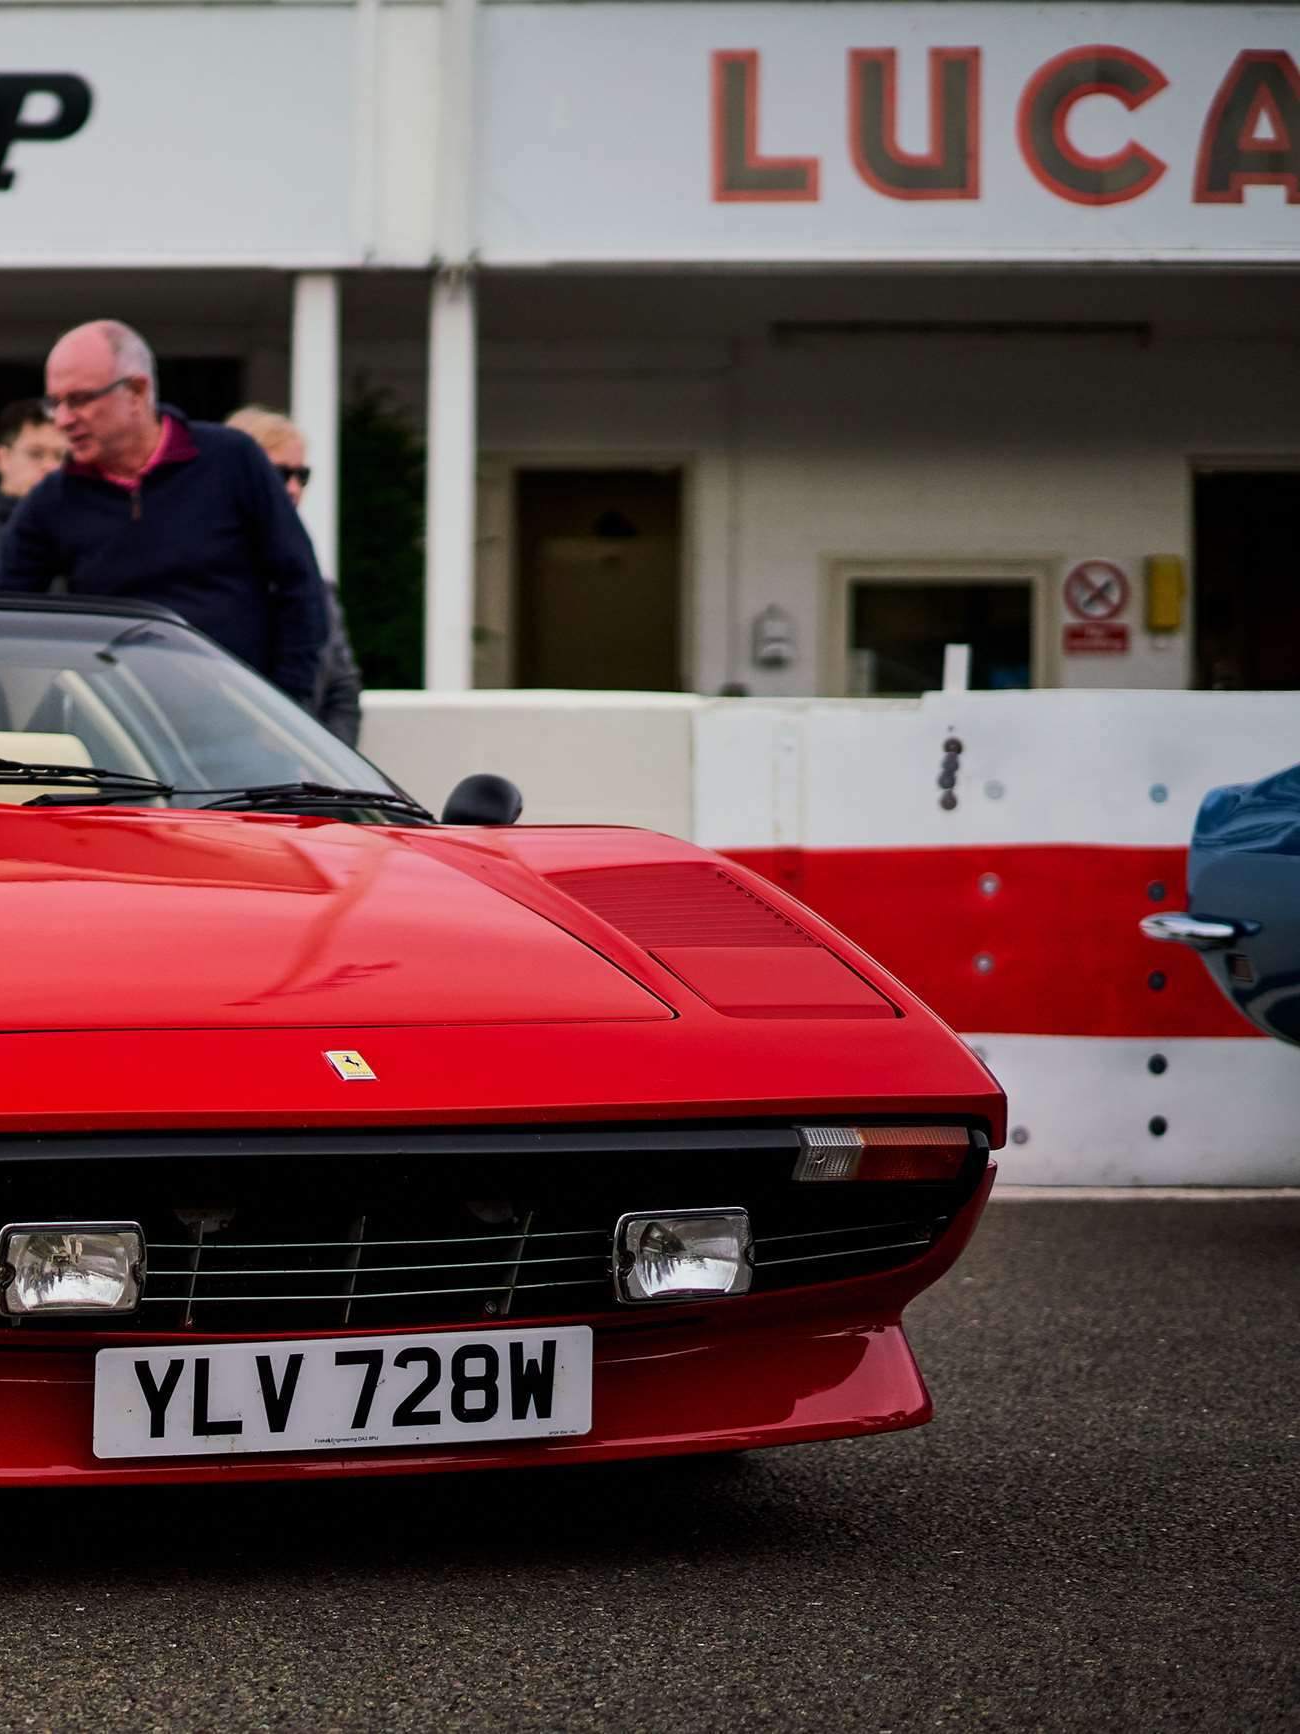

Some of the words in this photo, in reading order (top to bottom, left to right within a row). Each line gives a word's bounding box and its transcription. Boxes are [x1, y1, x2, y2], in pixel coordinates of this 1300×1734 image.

[710, 43, 1300, 206] LUCA
[134, 1353, 305, 1439] YLV
[333, 1339, 557, 1430] 728W
